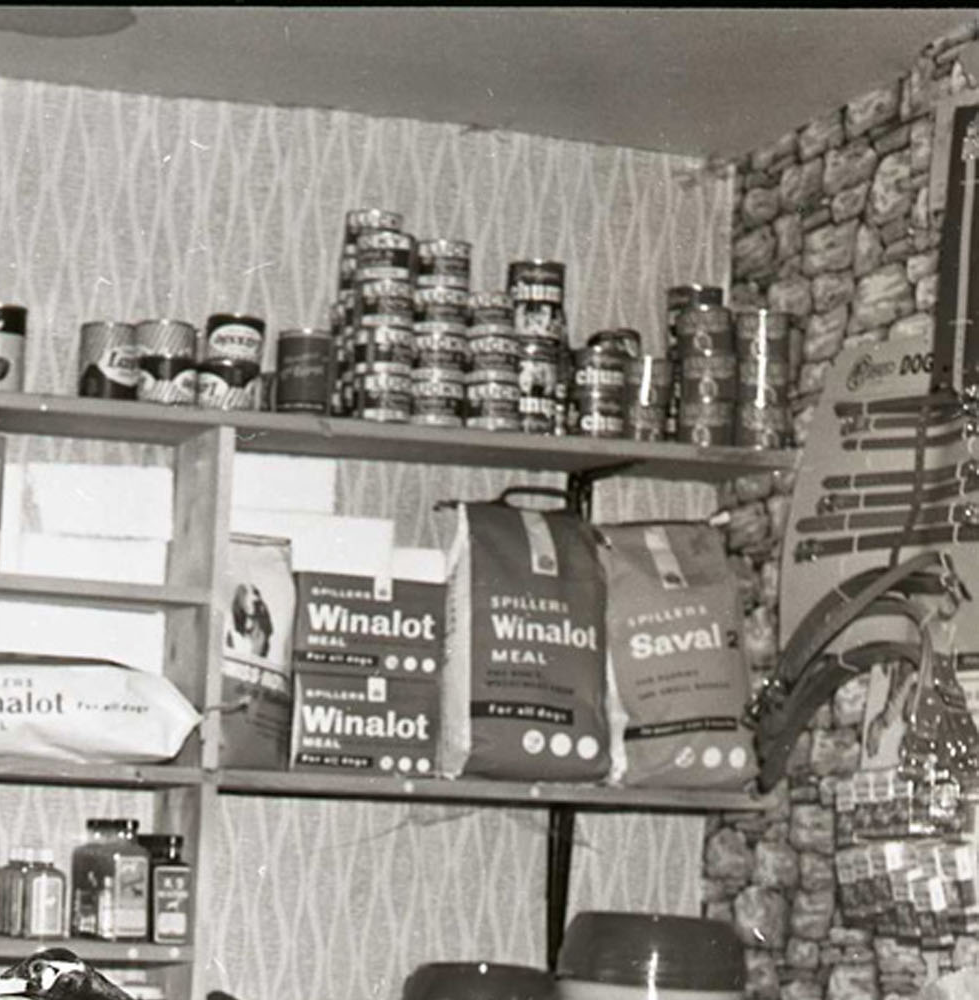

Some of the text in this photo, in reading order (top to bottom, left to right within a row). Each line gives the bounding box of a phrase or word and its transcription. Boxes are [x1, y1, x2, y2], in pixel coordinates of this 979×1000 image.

[310, 586, 372, 600] SPILLERS
[489, 596, 570, 614] SPILLERS
[307, 602, 437, 641] Winalot
[626, 606, 710, 628] SPILLERS
[490, 613, 598, 651] Winalot
[307, 635, 347, 648] MEAL
[629, 623, 722, 660] Saval
[491, 650, 548, 666] MEAL
[305, 688, 366, 701] SPILLERS
[302, 704, 431, 740] Winalot
[301, 736, 342, 749] MEAL
